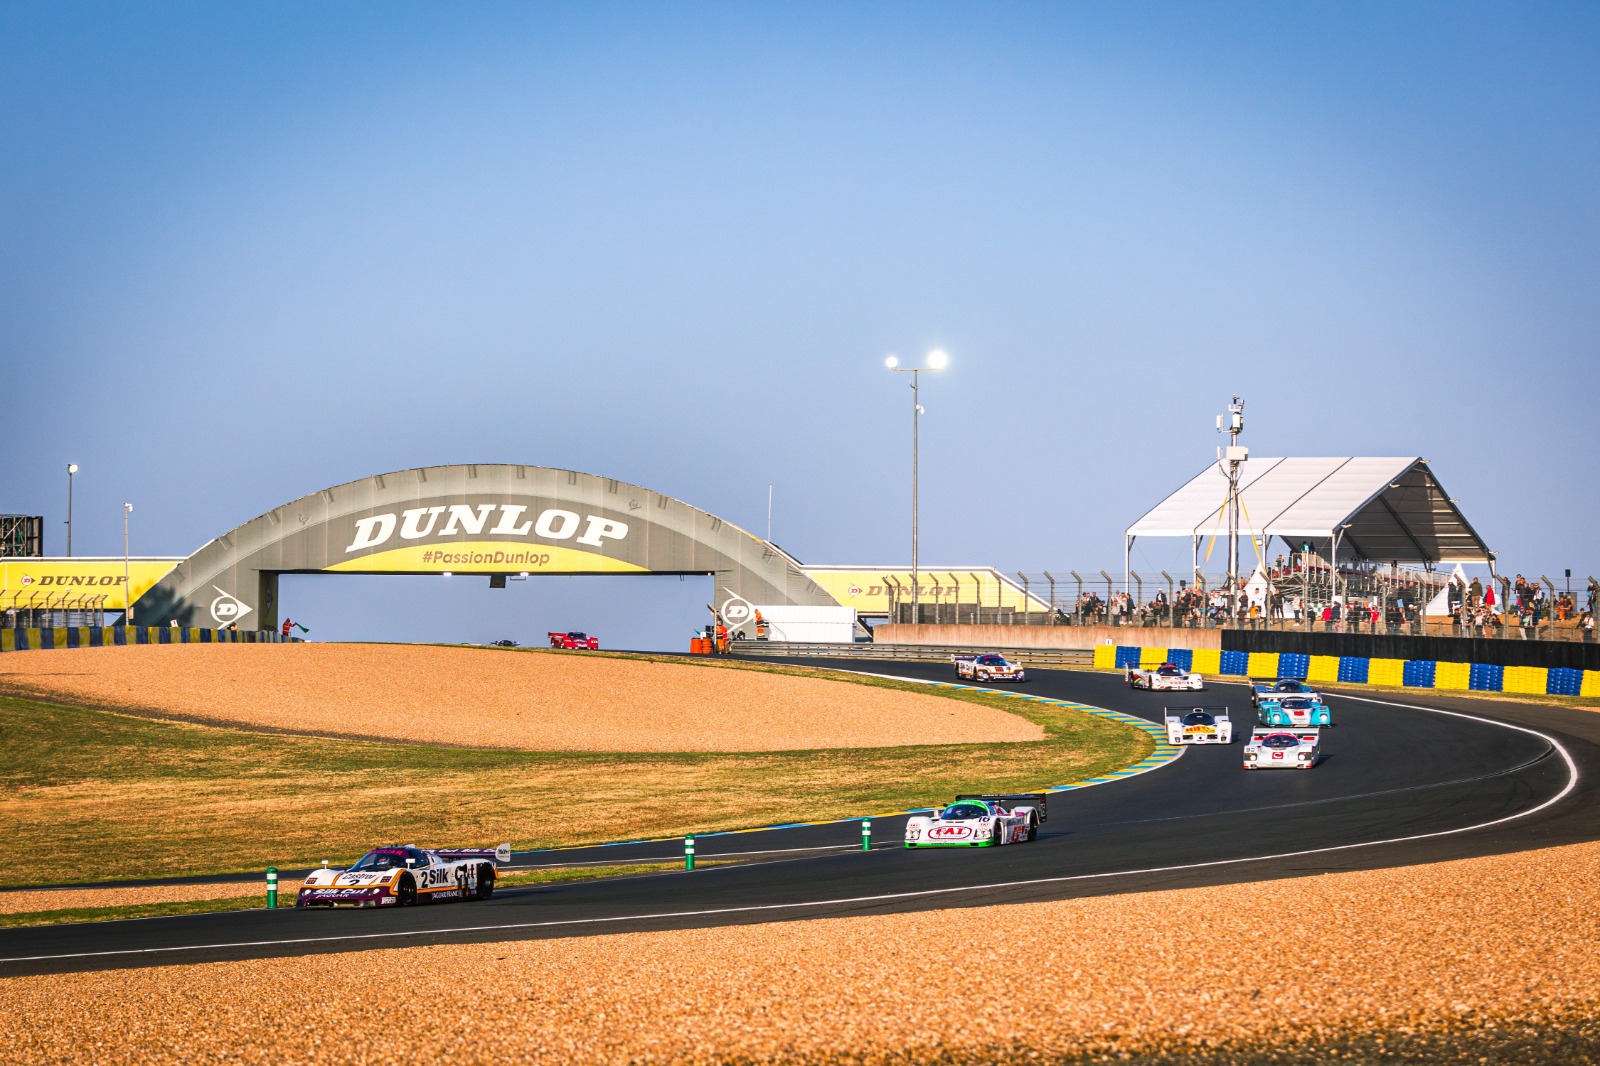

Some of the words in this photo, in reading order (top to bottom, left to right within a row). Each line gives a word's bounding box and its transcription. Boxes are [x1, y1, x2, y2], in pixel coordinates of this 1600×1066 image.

[345, 504, 629, 553] DUNLOP
[422, 551, 550, 567] #PassionDunlop
[38, 576, 129, 586] DUNLOP
[978, 815, 991, 823] 16
[421, 871, 429, 888] 2
[429, 868, 449, 885] Silk
[455, 863, 475, 882] Cut
